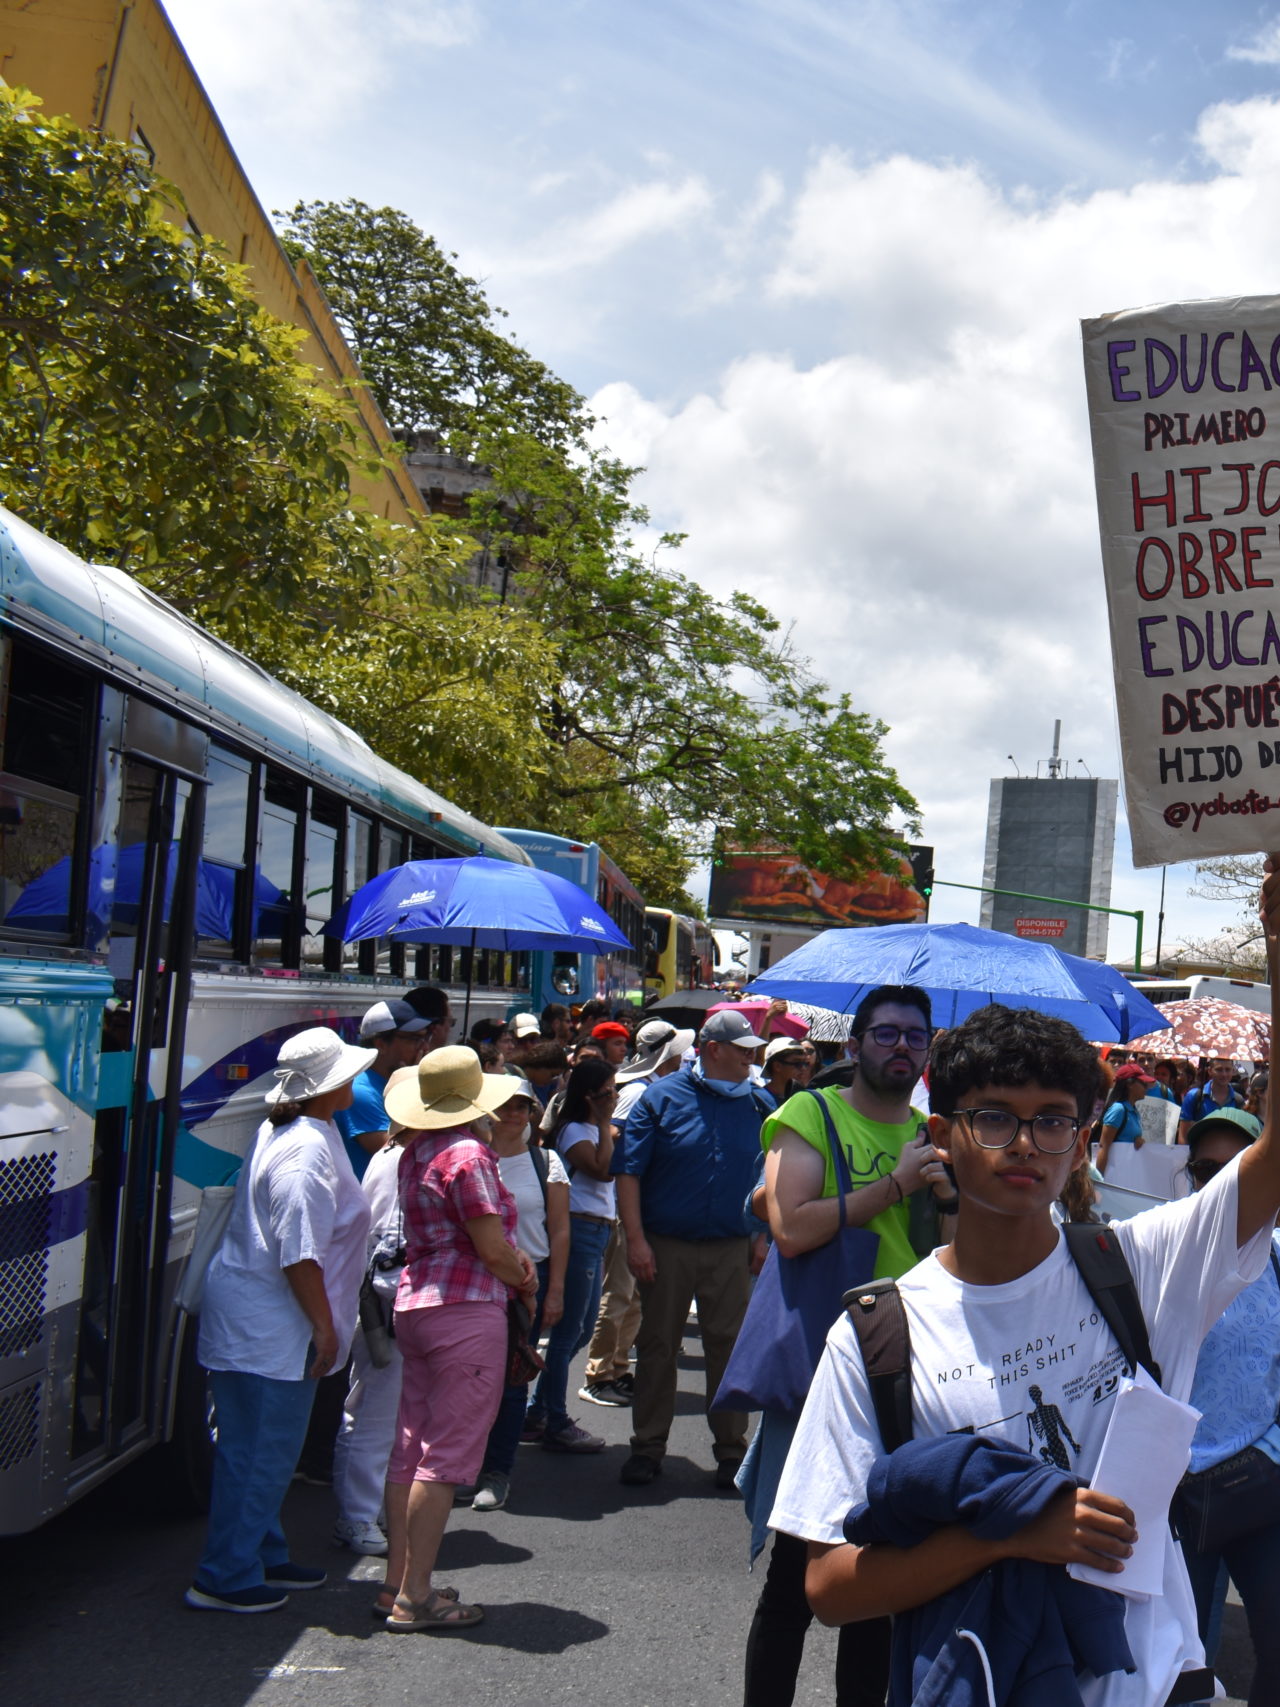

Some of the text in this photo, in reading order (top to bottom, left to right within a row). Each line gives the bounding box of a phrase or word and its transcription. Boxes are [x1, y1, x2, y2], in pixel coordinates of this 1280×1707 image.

[1144, 407, 1266, 451] PRIMERO
[1159, 745, 1242, 784] HIJO
[845, 1143, 897, 1178] UC
[938, 1312, 1100, 1384] NOT READY FO
[988, 1364, 1029, 1389] THIS
[1036, 1343, 1076, 1370] SHIT
